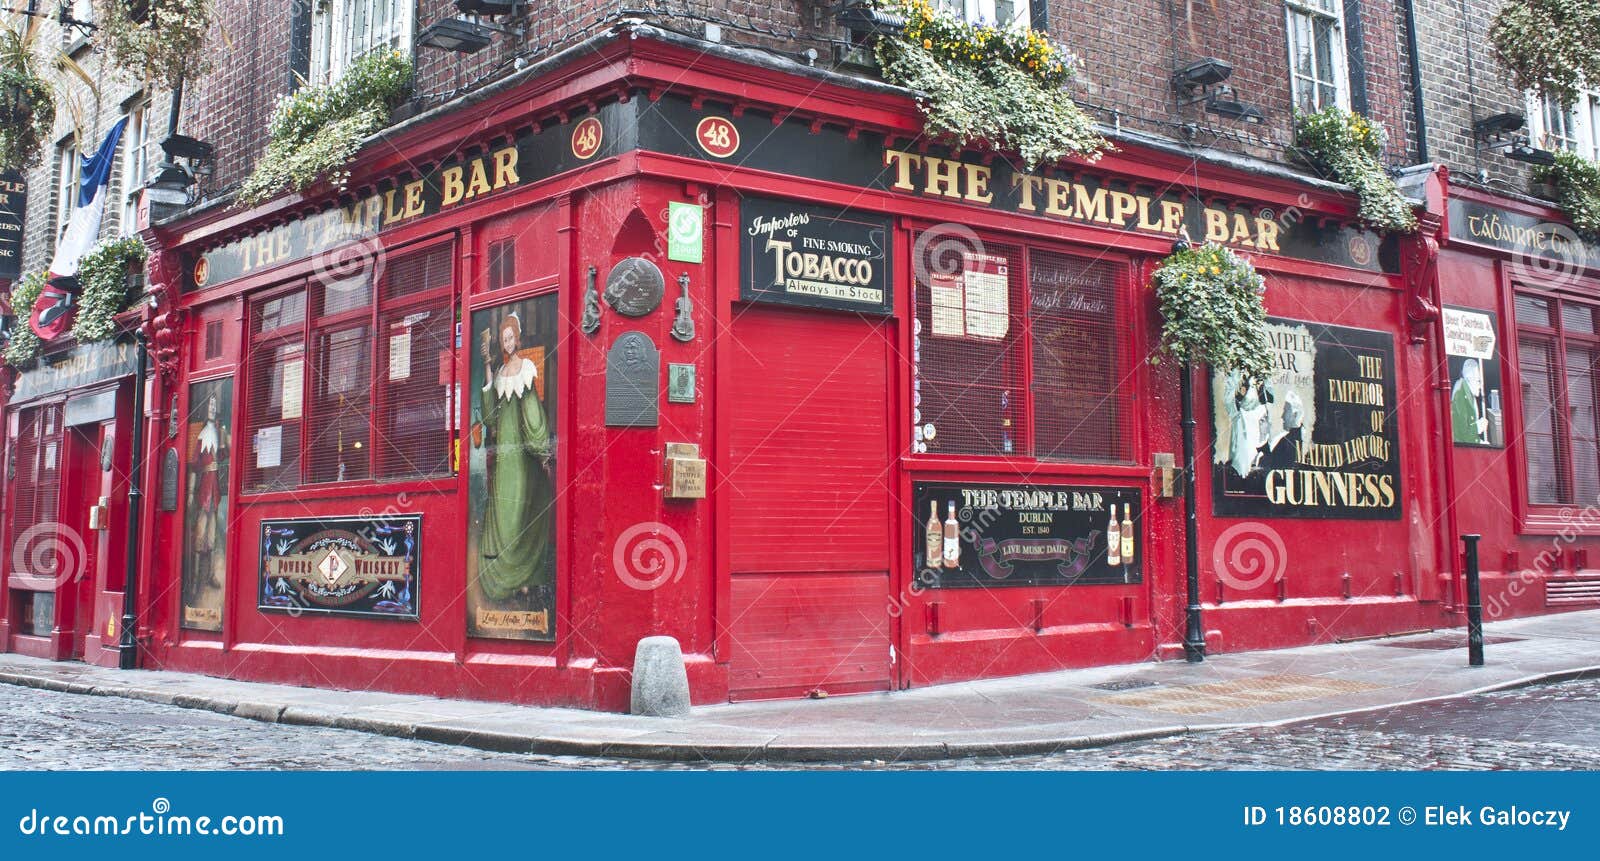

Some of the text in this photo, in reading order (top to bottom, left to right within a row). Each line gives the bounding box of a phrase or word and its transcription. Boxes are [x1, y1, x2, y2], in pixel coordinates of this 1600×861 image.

[577, 125, 597, 153] 48
[704, 122, 731, 148] 48
[240, 147, 520, 272] THE TEMPLE BAR
[886, 150, 1280, 251] THE TEMPLE BAR
[0, 222, 21, 232] DEN
[748, 212, 810, 239] Importers
[786, 229, 799, 238] OF
[803, 237, 872, 256] FINE SMOKING
[765, 238, 873, 286] TOBACCO
[788, 279, 881, 301] Always in Stock
[1357, 355, 1383, 380] THE
[1328, 379, 1384, 407] EMPEROR
[1370, 410, 1385, 433] OF
[1295, 434, 1391, 468] MALTED LIQUORS
[961, 489, 1104, 511] THE TEMPLE BAR
[1265, 469, 1395, 509] GUINNESS
[1019, 512, 1053, 523] DUBLIN
[1002, 544, 1069, 556] LIVE MUSIC DAILY
[278, 559, 312, 575] POWERS
[355, 559, 400, 575] WHISKEY
